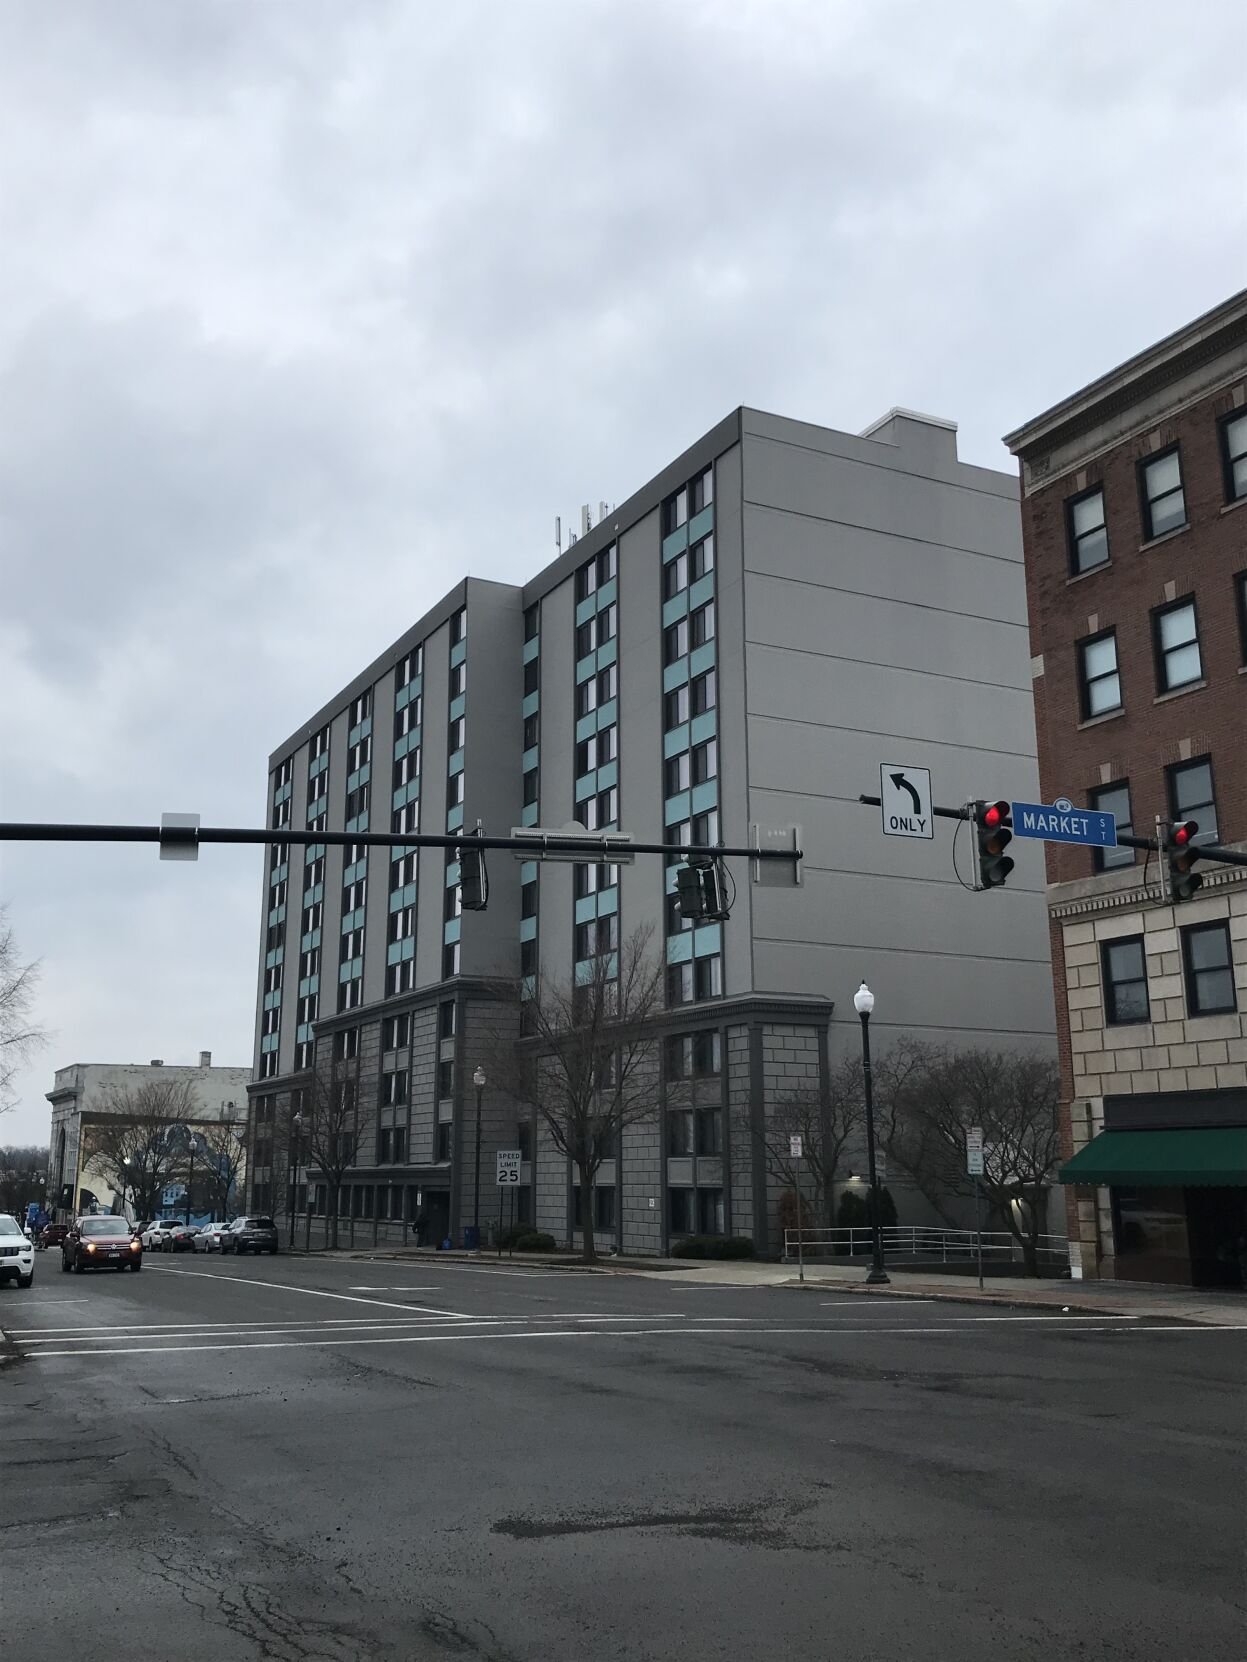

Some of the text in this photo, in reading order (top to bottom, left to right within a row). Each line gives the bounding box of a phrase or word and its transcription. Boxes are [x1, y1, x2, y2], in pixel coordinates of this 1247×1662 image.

[890, 816, 926, 832] ONLY
[1023, 811, 1089, 836] MARKET
[498, 1170, 519, 1182] 25
